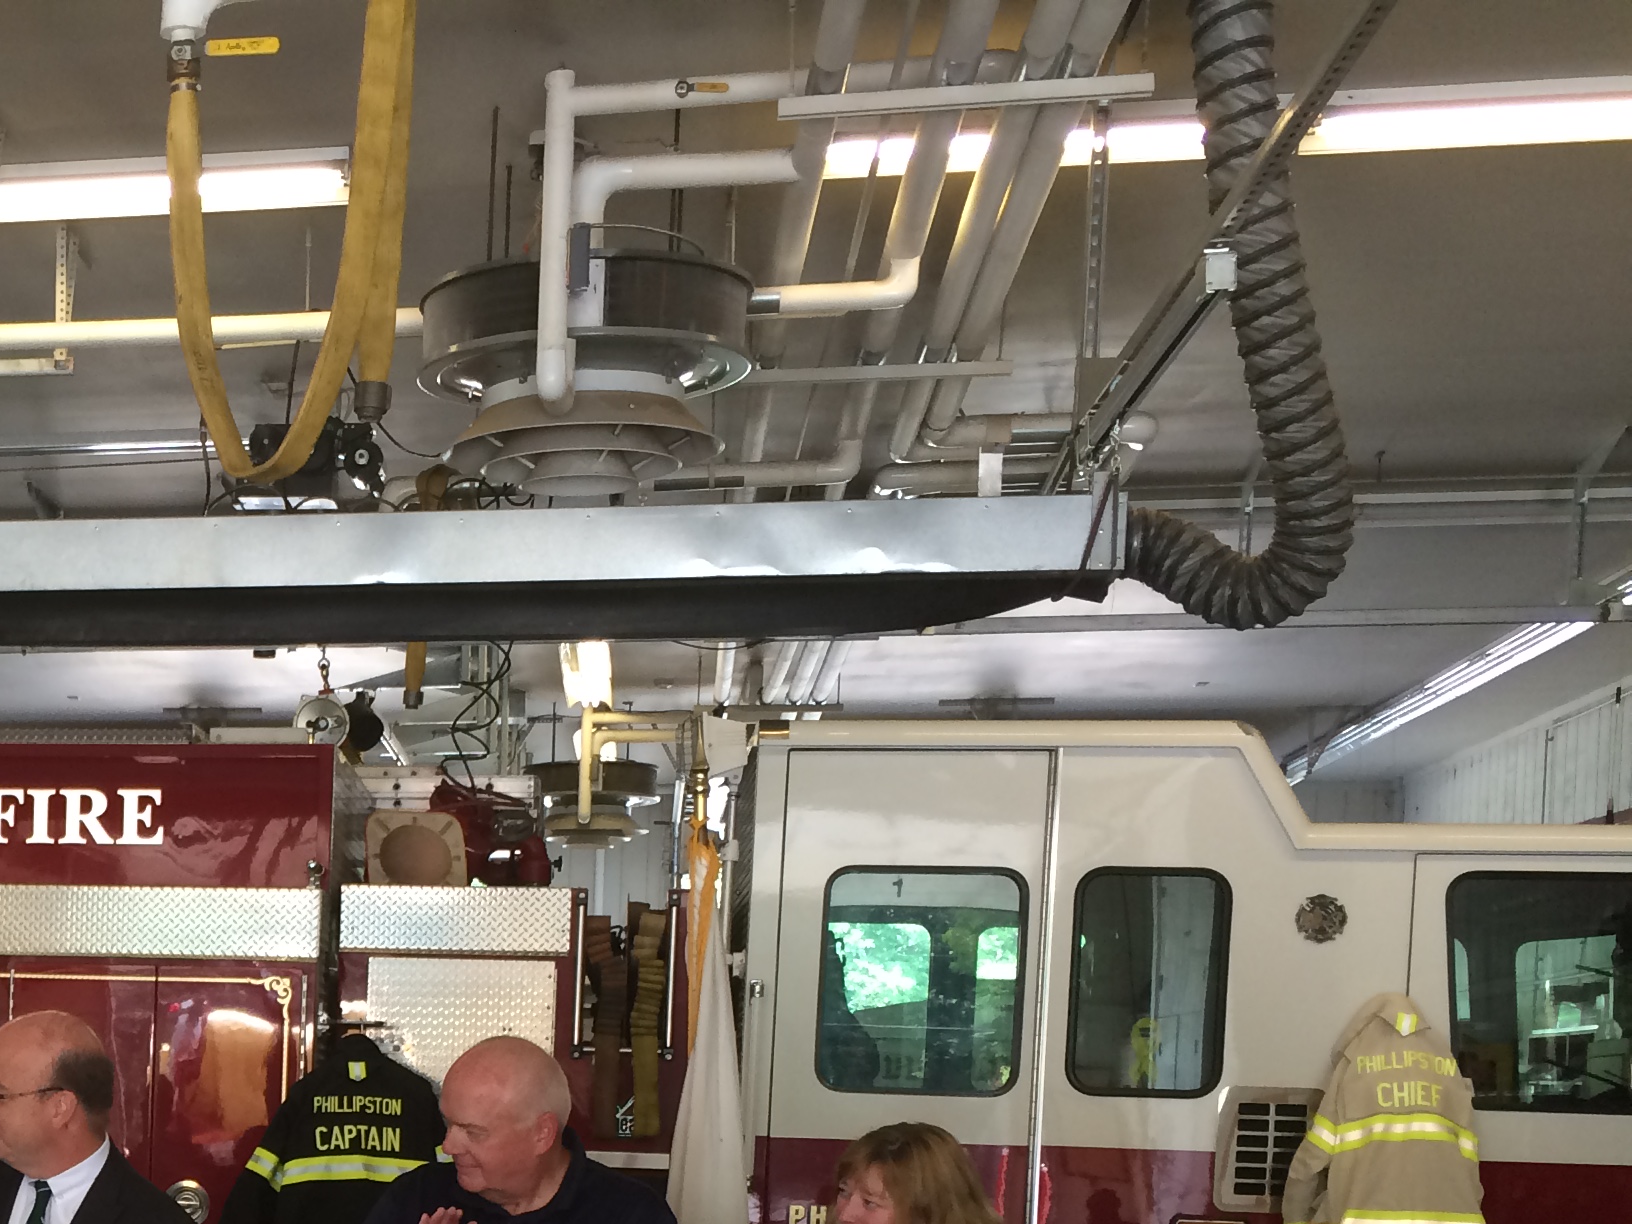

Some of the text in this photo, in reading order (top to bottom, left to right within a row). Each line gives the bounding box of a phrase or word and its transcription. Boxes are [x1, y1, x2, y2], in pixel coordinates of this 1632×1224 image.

[313, 1095, 402, 1116] PHILLIPSTON
[1376, 1080, 1443, 1107] CHIEF
[314, 1124, 400, 1152] CAPTAIN
